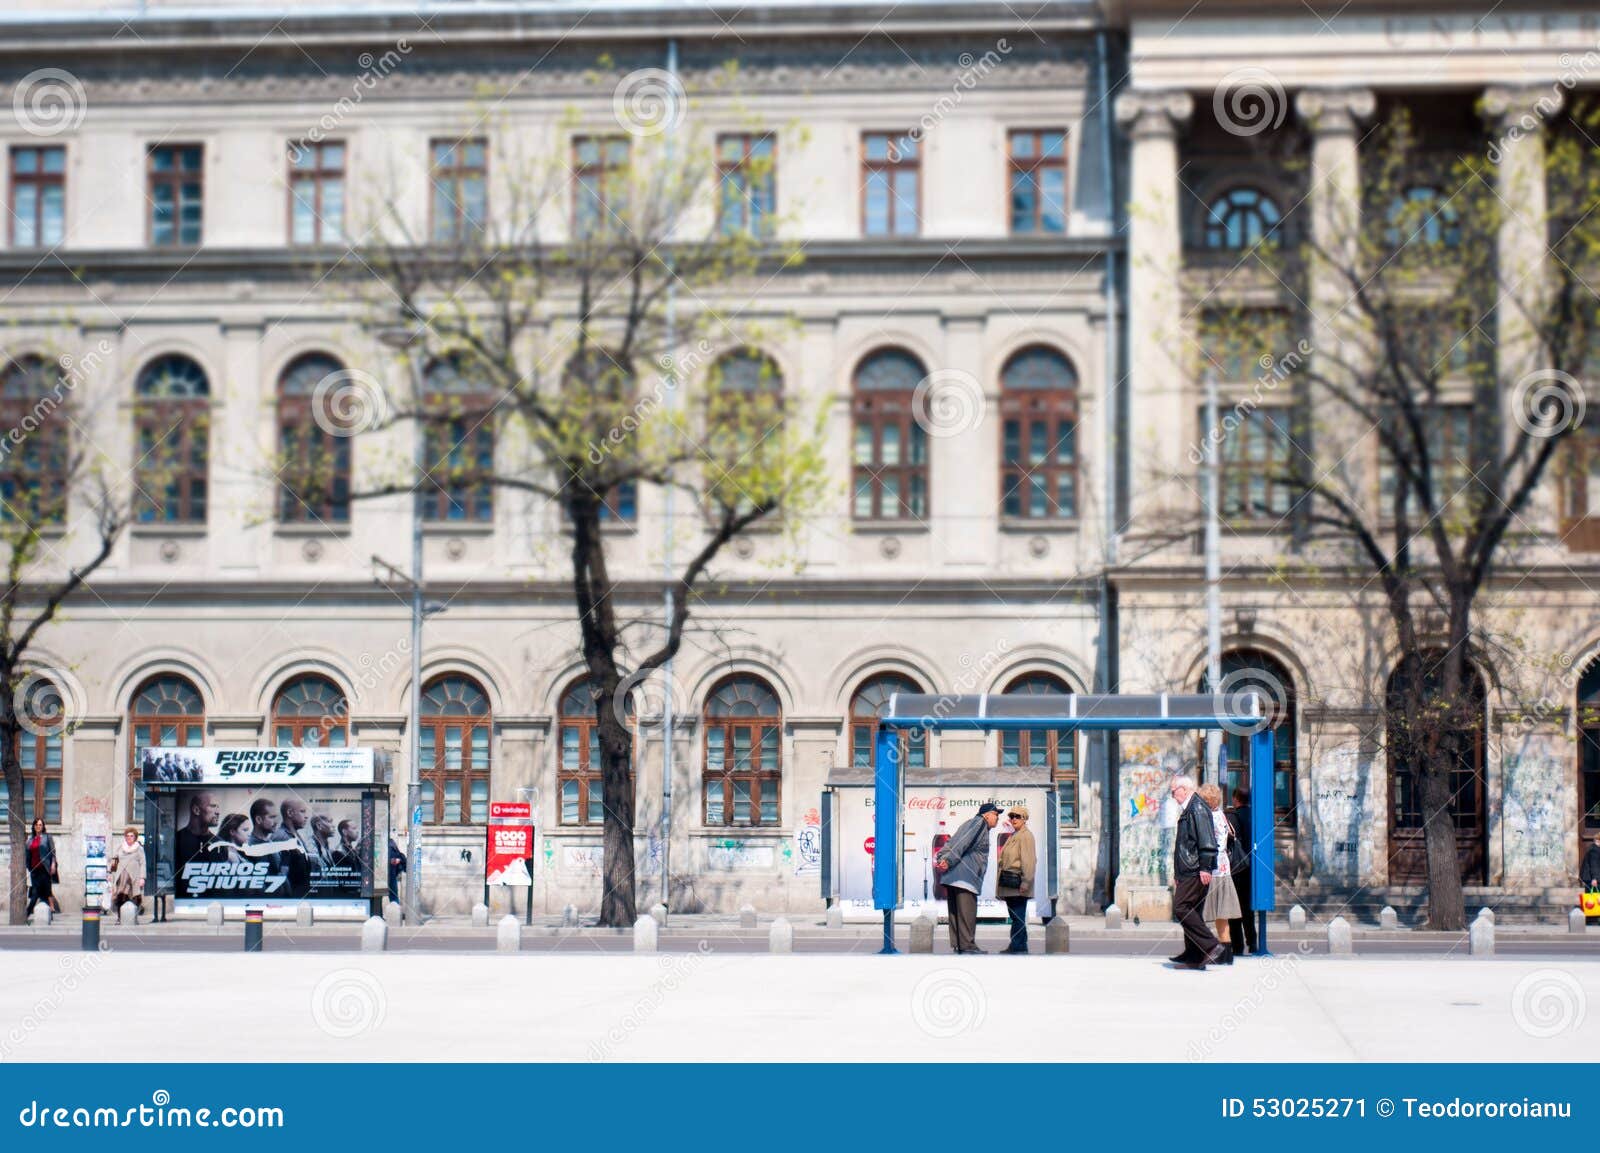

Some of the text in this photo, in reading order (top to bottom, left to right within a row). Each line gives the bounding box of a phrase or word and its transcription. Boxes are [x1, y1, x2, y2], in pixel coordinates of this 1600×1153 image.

[216, 751, 290, 764] FURIOS
[949, 799, 985, 808] pentru
[495, 831, 526, 841] 2000
[181, 862, 270, 879] FURIOS
